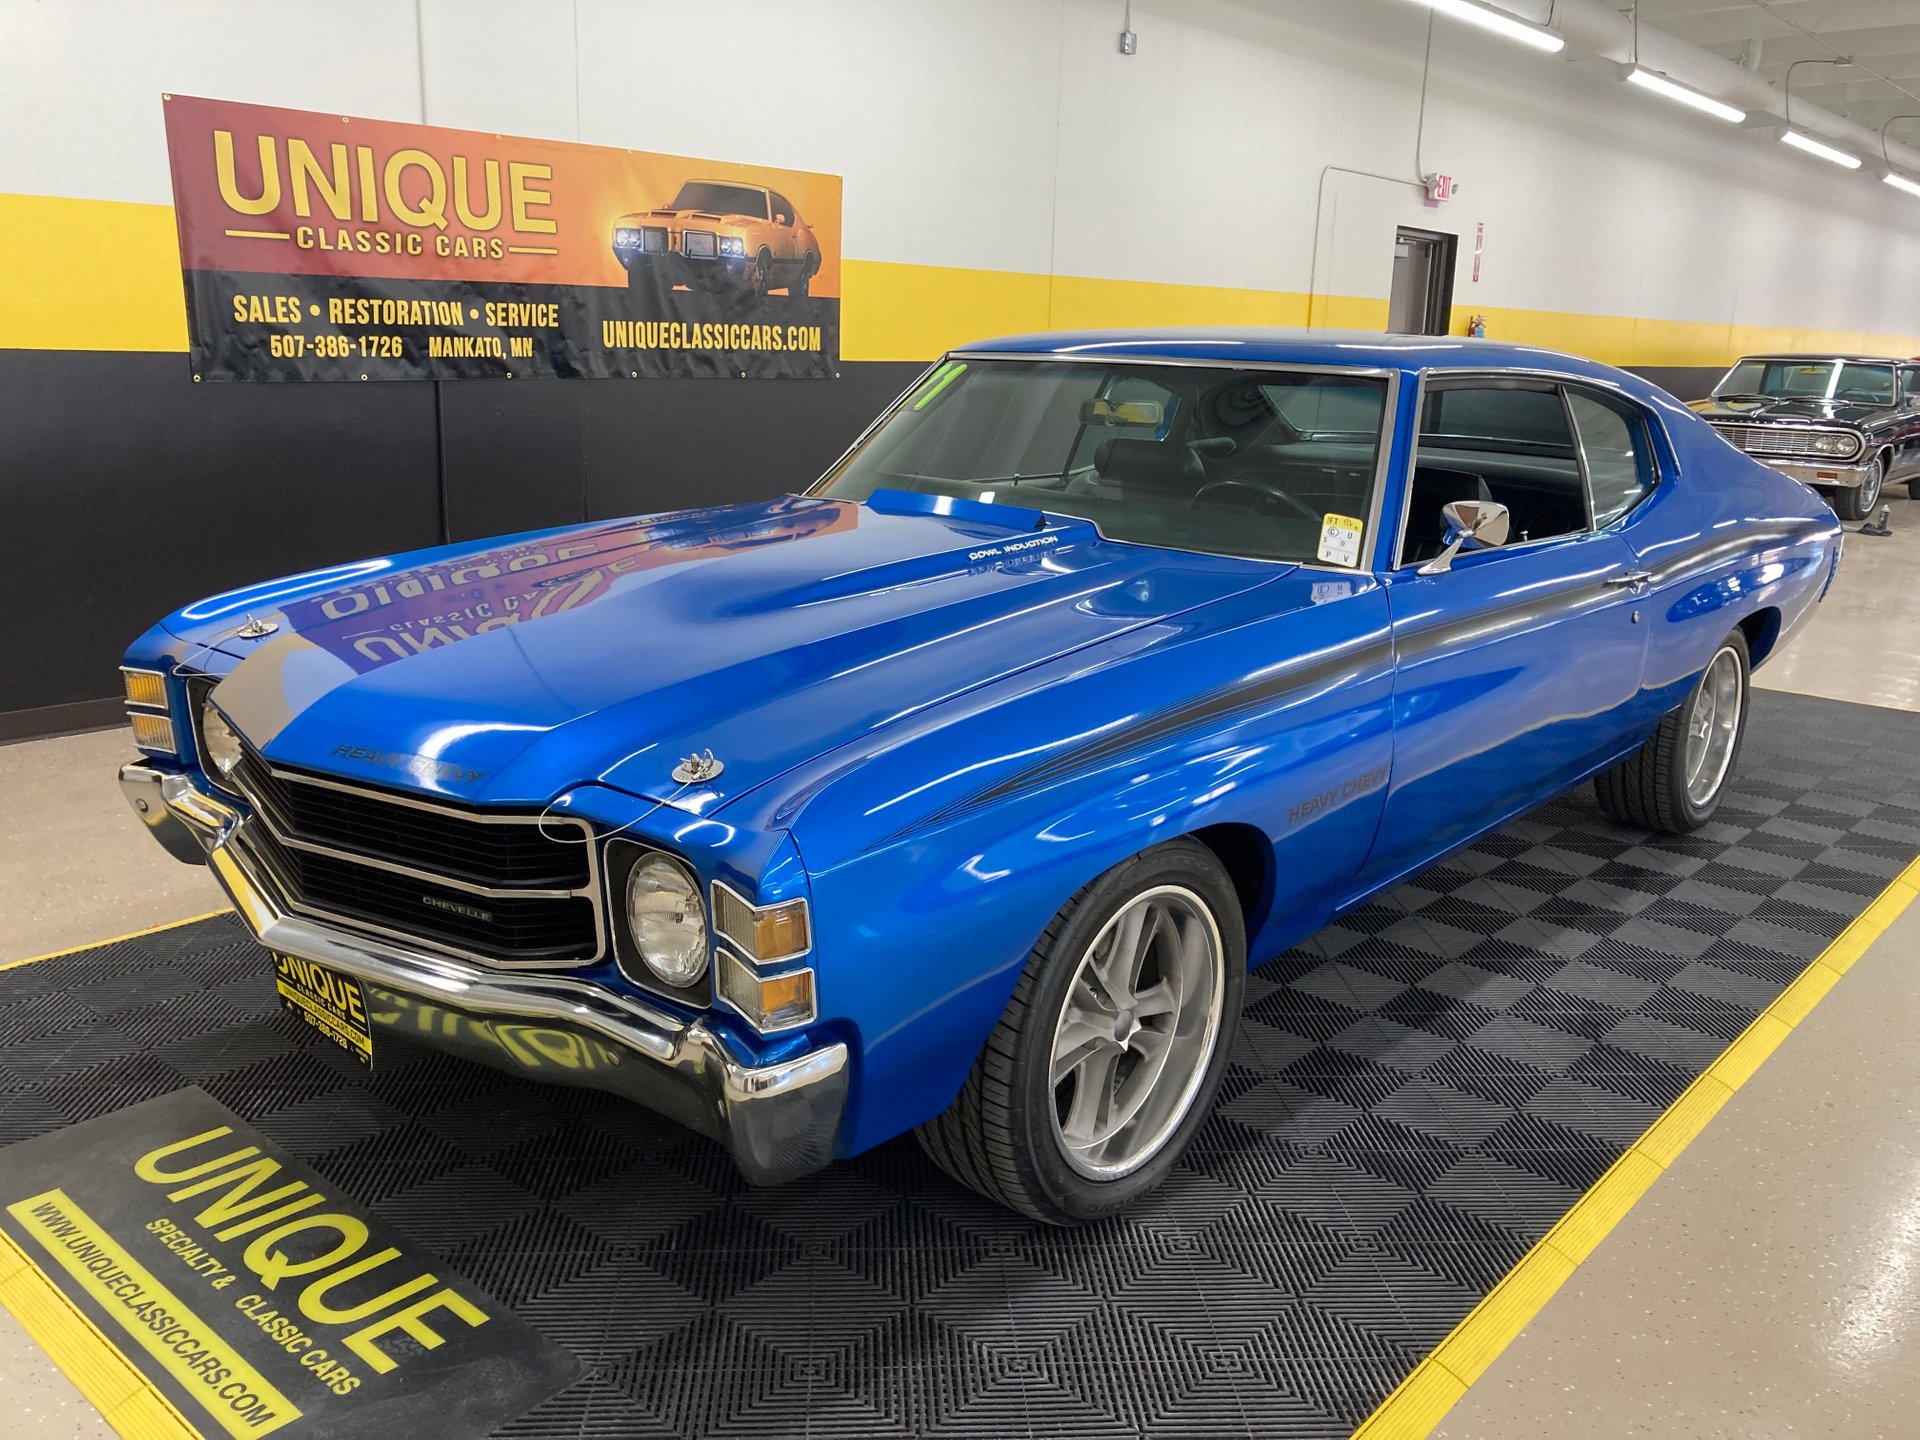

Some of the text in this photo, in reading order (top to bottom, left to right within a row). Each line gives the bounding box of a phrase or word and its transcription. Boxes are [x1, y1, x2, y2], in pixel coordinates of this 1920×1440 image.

[213, 130, 557, 234] UNIQUE
[1437, 175, 1452, 199] EXIT
[296, 226, 504, 259] CLASSIC CARS
[233, 295, 559, 328] SALES RESTORATION SERVICE
[270, 335, 533, 360] 507-386-1726 MANKATO, MN
[603, 320, 821, 351] UNIQUECLASSICCARS.COM
[968, 536, 1059, 561] COWL INDUCTION
[331, 743, 405, 767] HEAVY
[1288, 764, 1388, 823] HEAVY CHEVY
[422, 896, 492, 921] CHEVELLE
[134, 1125, 490, 1375] UNIQUE
[30, 1202, 277, 1427] WWW.UNIQUECLASSICCARS.COM
[145, 1218, 361, 1396] SPECIALTY & CLASSIC CARS
